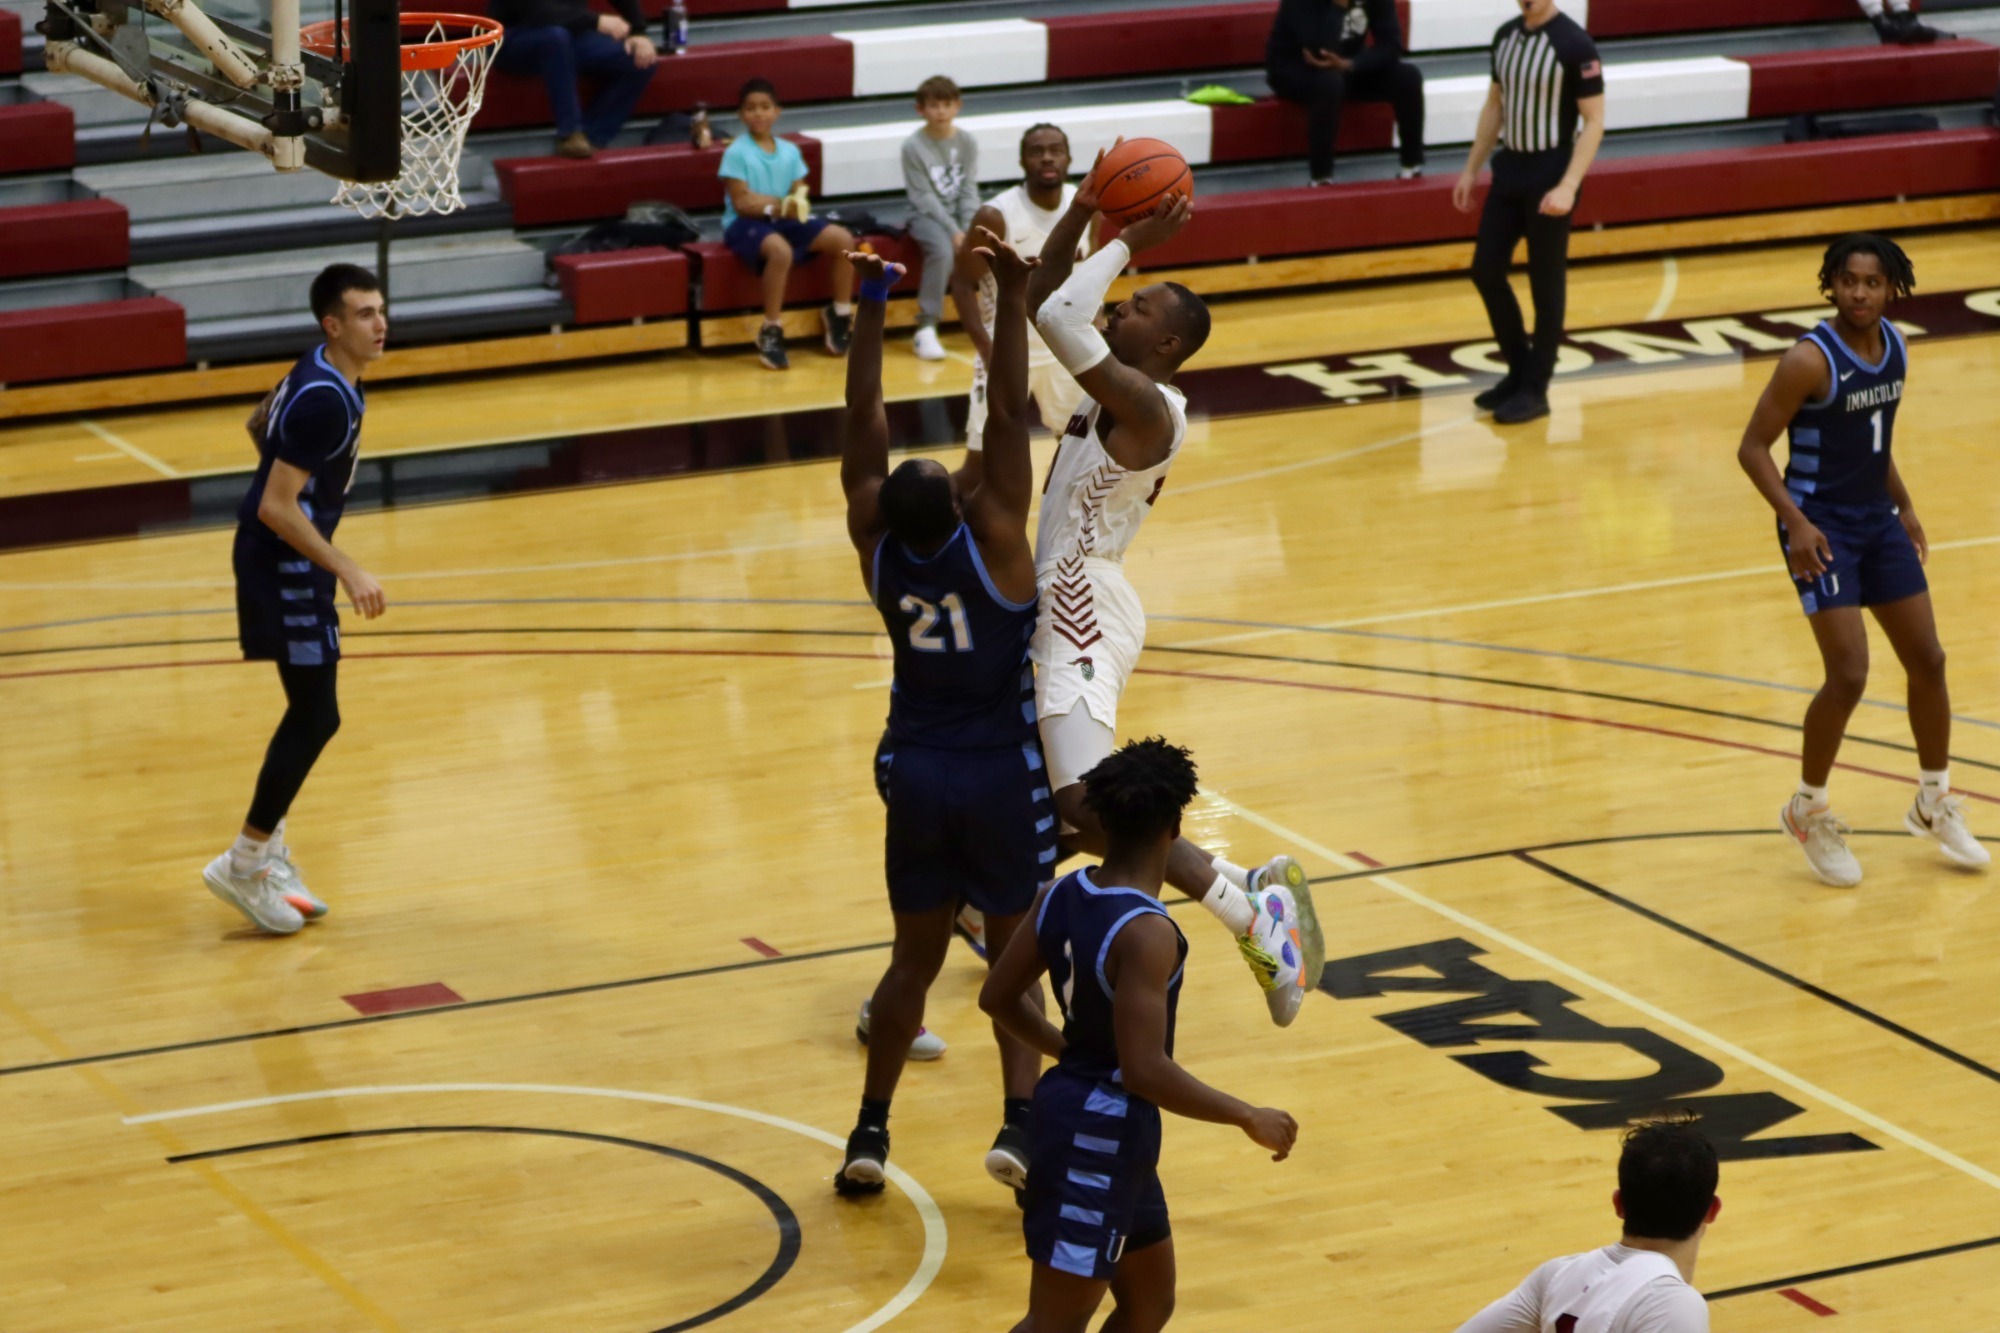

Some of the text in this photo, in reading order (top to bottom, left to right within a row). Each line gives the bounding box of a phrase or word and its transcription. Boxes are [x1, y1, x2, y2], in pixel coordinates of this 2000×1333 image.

[1870, 409, 1883, 454] 1
[899, 592, 974, 653] 21
[1317, 937, 1885, 1163] NCAA
